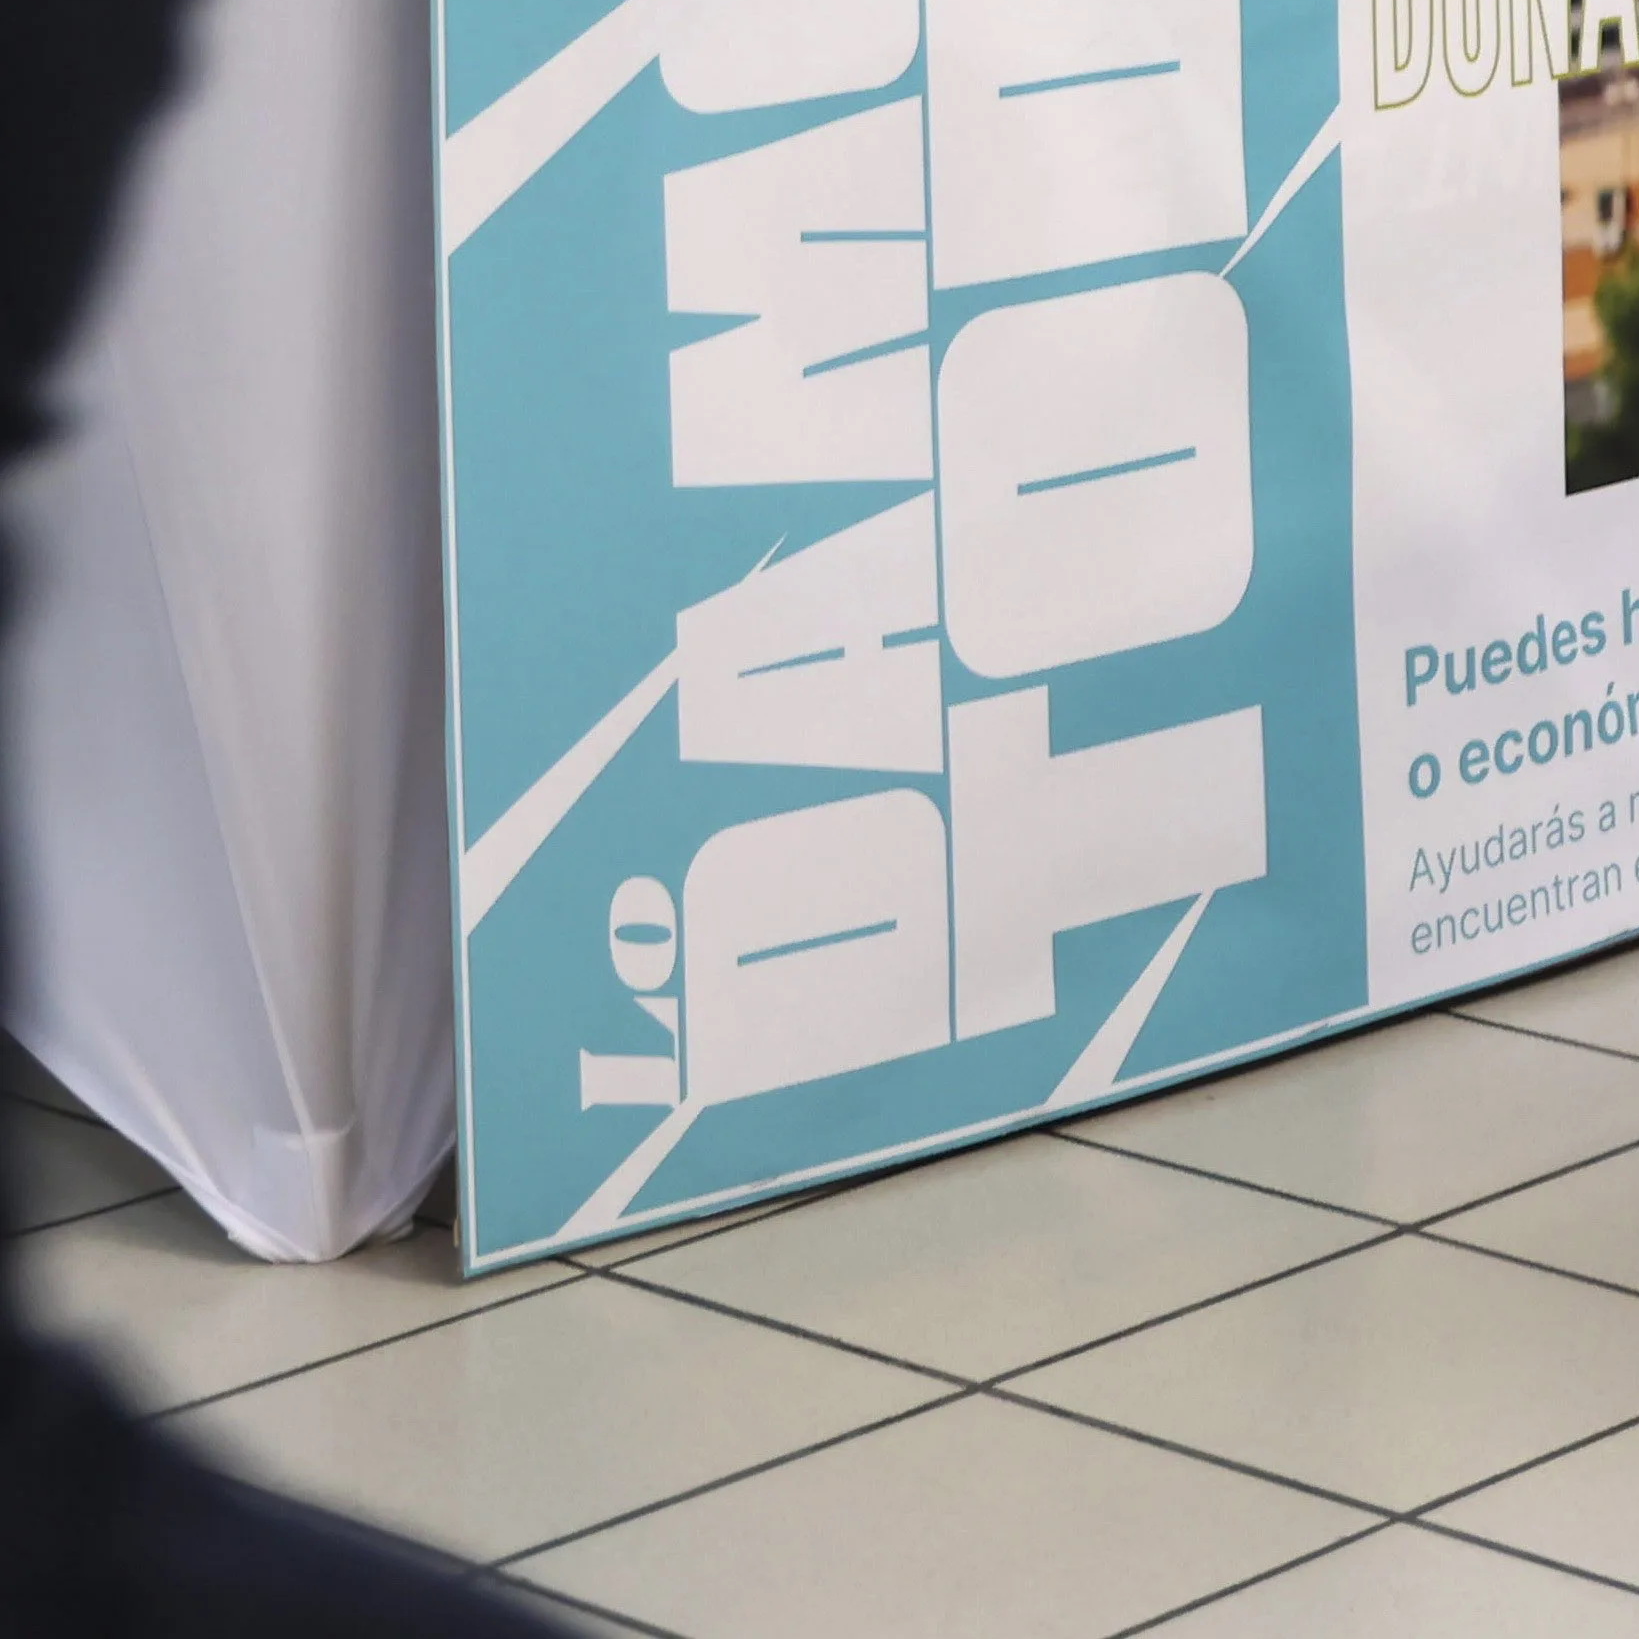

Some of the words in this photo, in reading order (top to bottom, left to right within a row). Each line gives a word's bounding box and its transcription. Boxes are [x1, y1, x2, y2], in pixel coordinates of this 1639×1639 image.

[1404, 610, 1607, 707] Puedes
[1408, 752, 1441, 799] o
[1409, 806, 1586, 892] Ayudarás
[1599, 803, 1617, 832] a
[1411, 866, 1622, 954] encuentran
[580, 876, 680, 1109] LO
